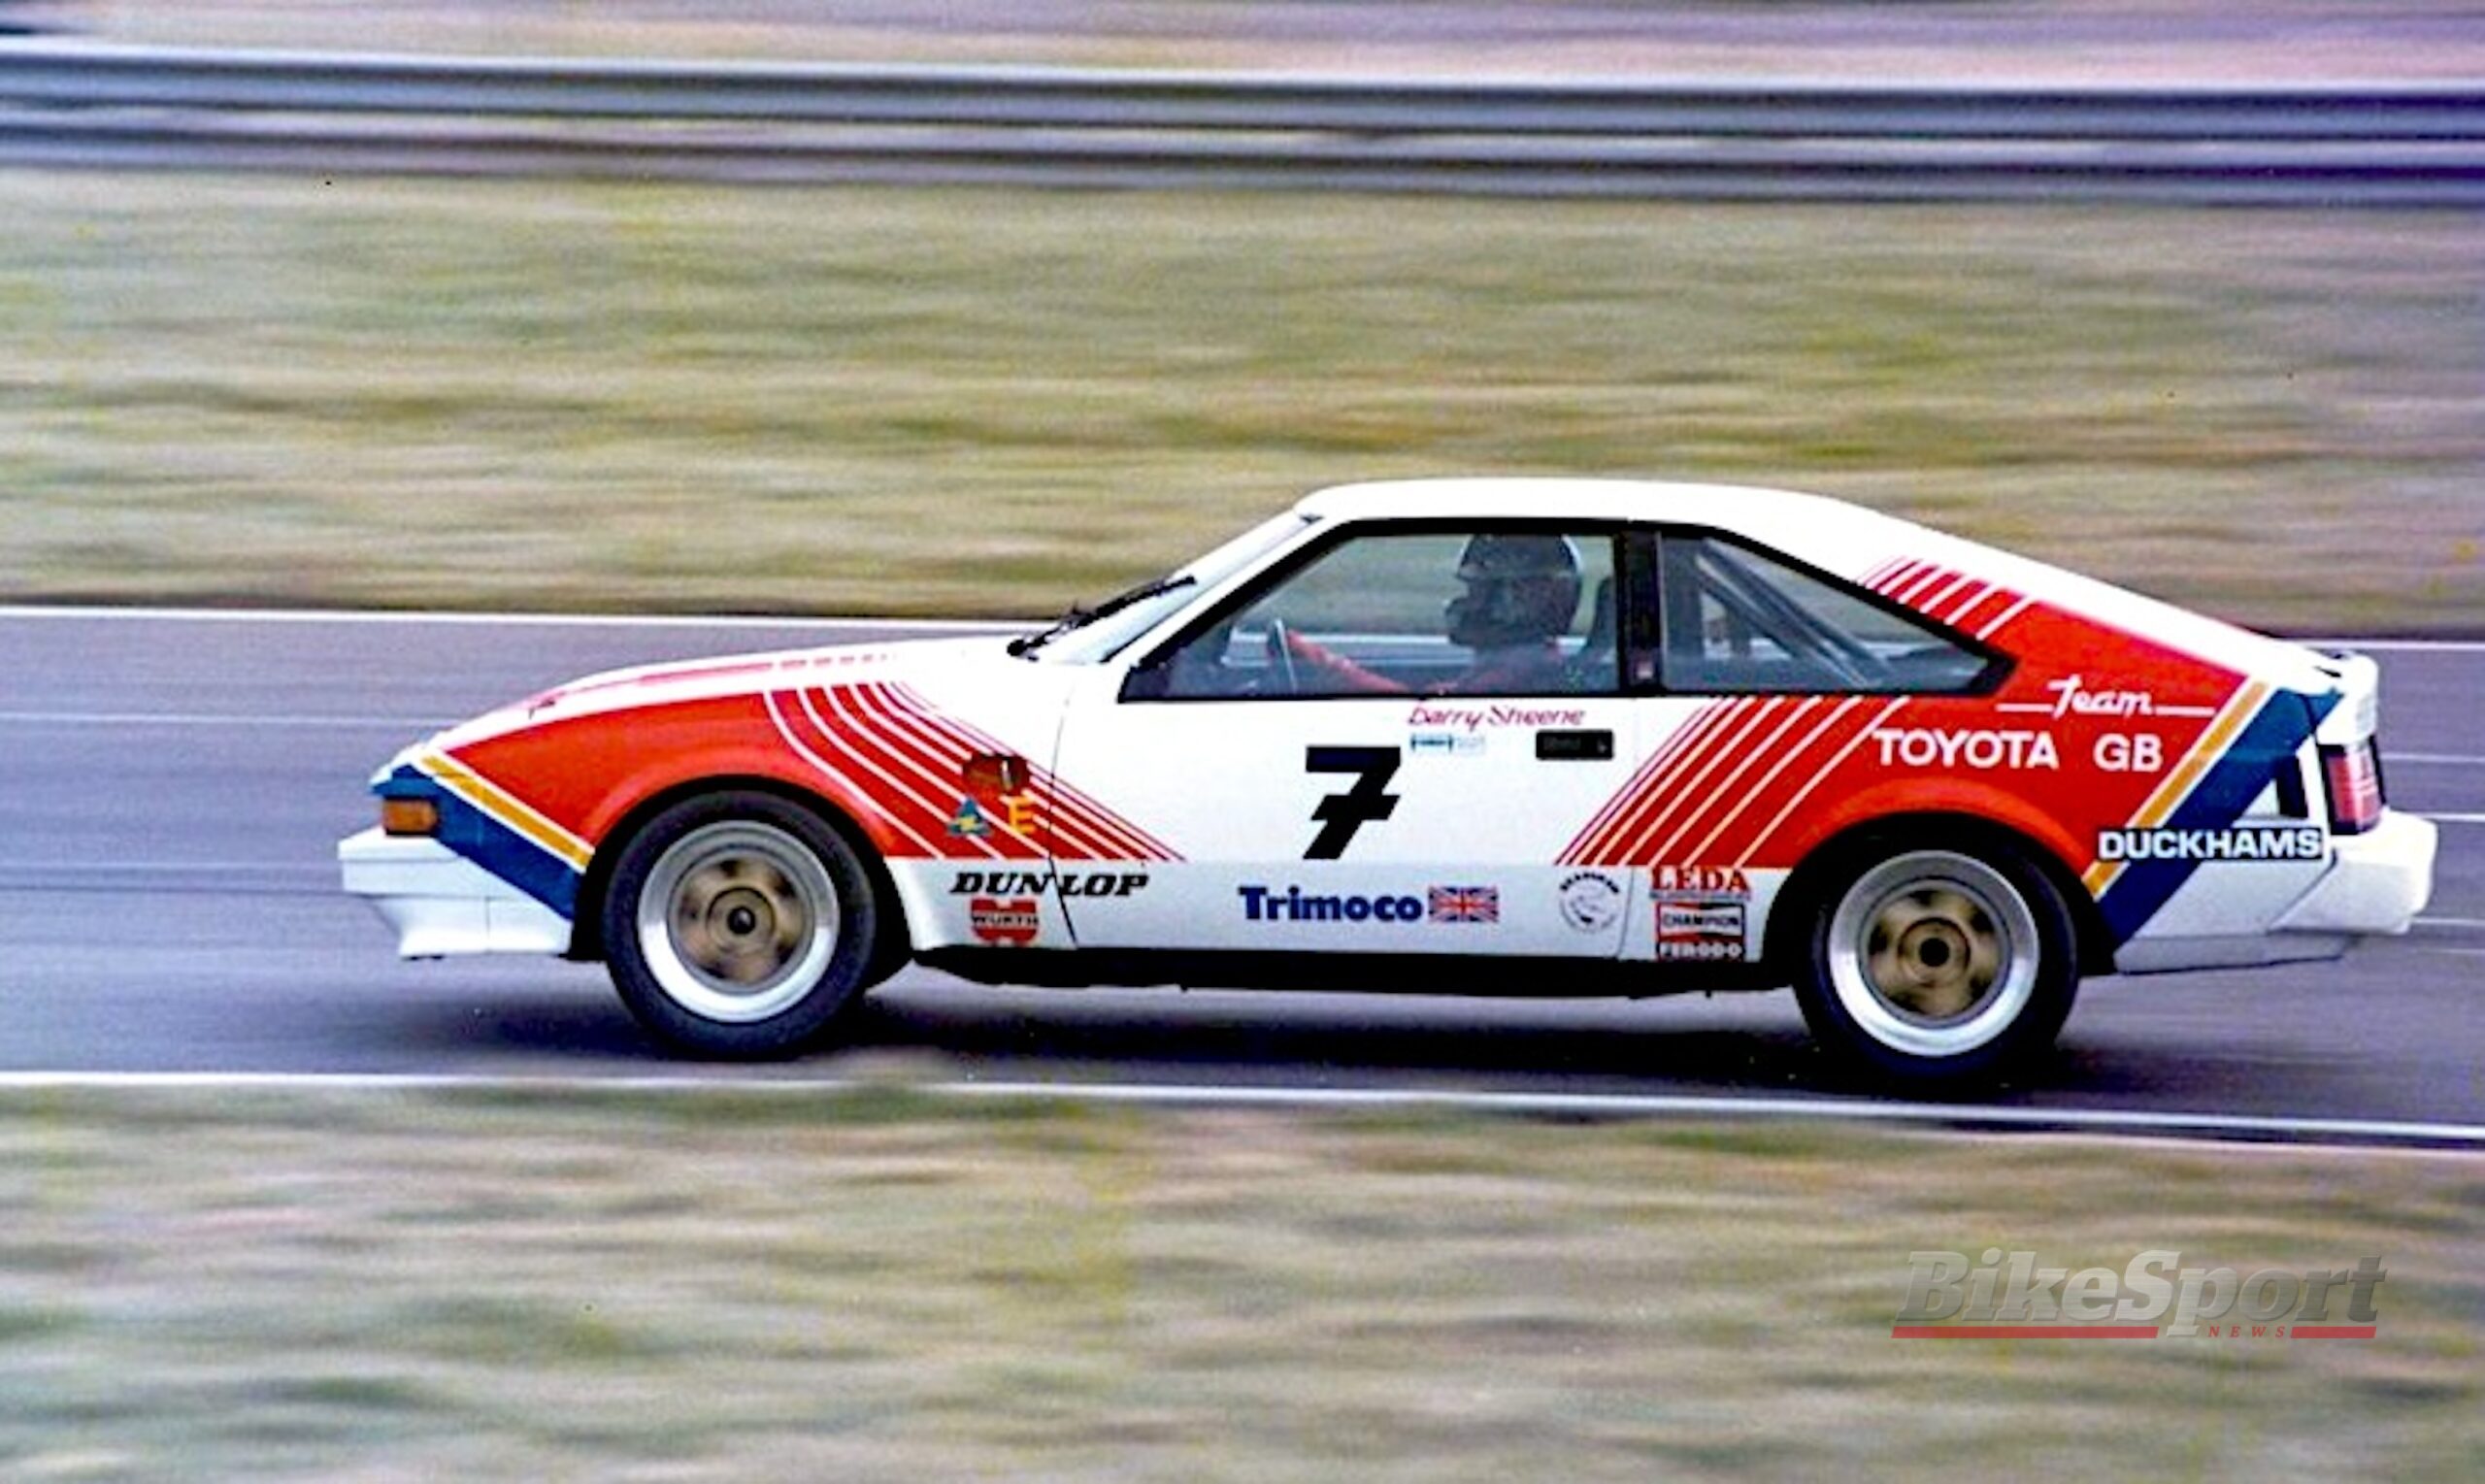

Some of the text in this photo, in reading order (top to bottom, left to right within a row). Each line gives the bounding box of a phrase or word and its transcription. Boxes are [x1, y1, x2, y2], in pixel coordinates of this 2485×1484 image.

[2048, 673, 2153, 718] Team
[1872, 728, 2164, 773] TOYOTA GB
[1009, 795, 1036, 833] E
[1303, 745, 1402, 860] 7
[2098, 828, 2321, 860] DUCKHAMS
[950, 873, 1147, 896] DUNLOP
[1651, 867, 1749, 891] LEDA
[1238, 884, 1424, 920] Trimoco
